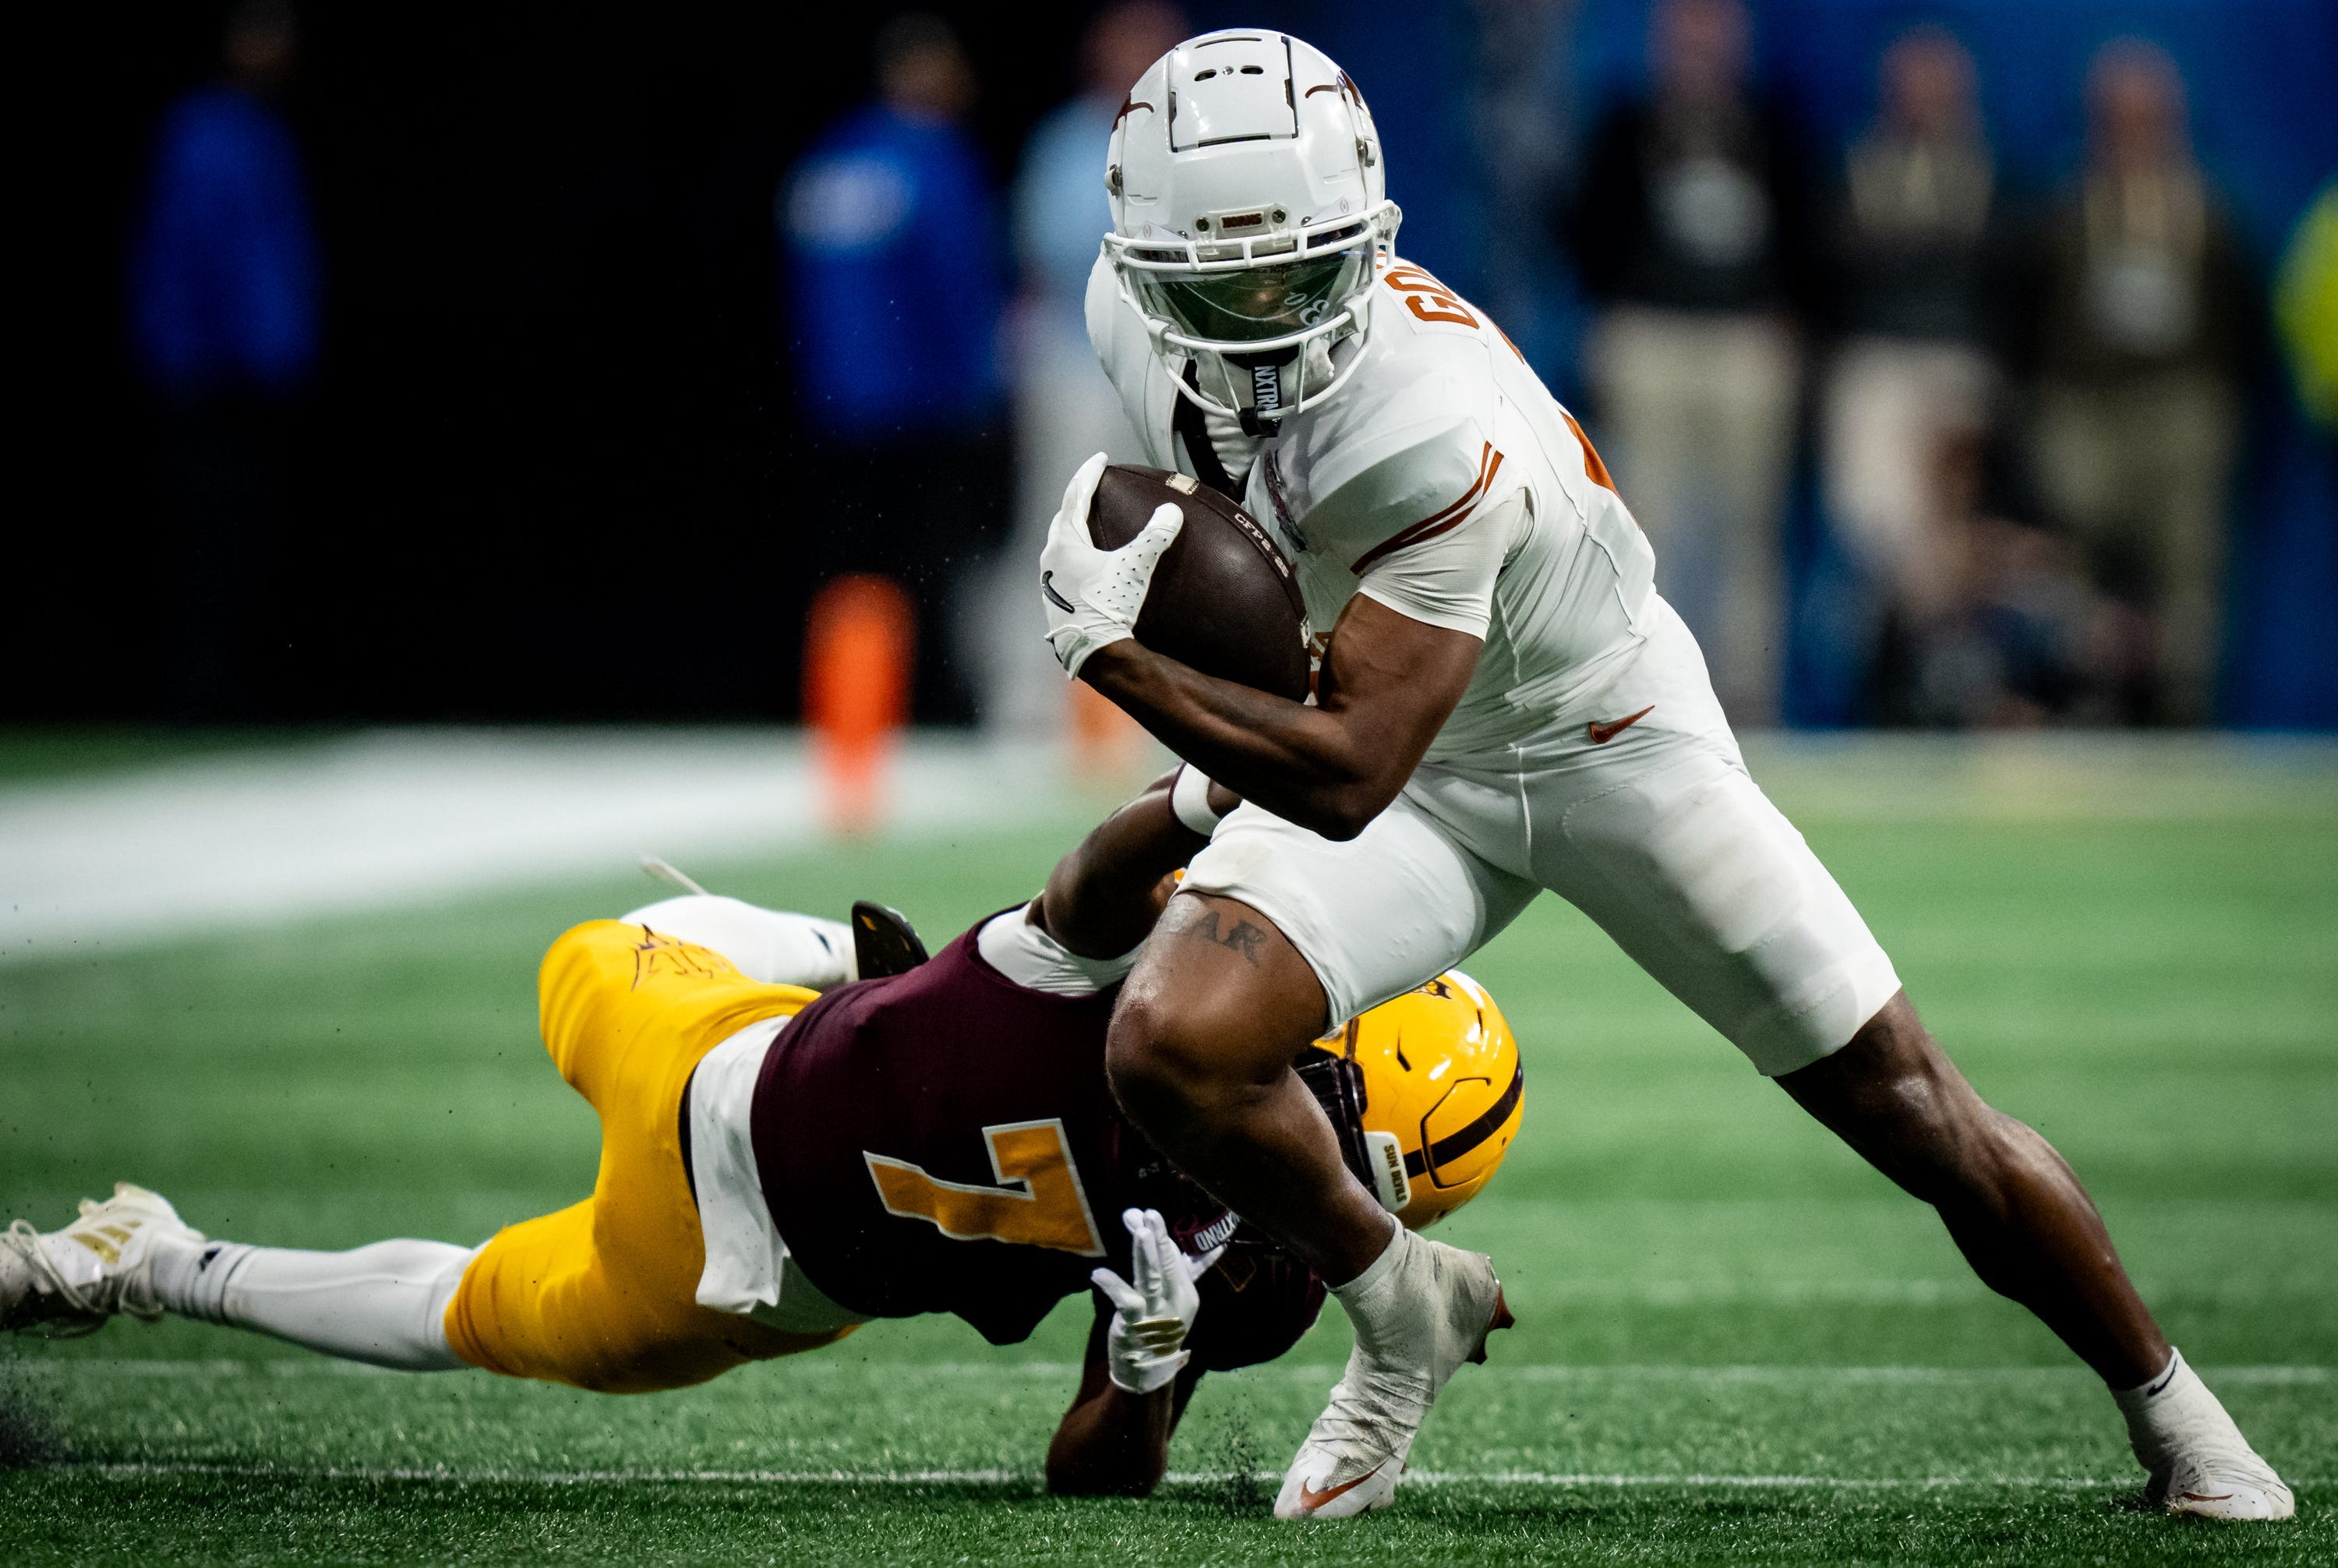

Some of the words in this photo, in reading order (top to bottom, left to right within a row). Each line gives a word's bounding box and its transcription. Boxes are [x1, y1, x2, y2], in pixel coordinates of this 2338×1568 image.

[1184, 909, 1268, 967] AR
[1383, 1143, 1400, 1168] SUN
[862, 1117, 1107, 1257] 7
